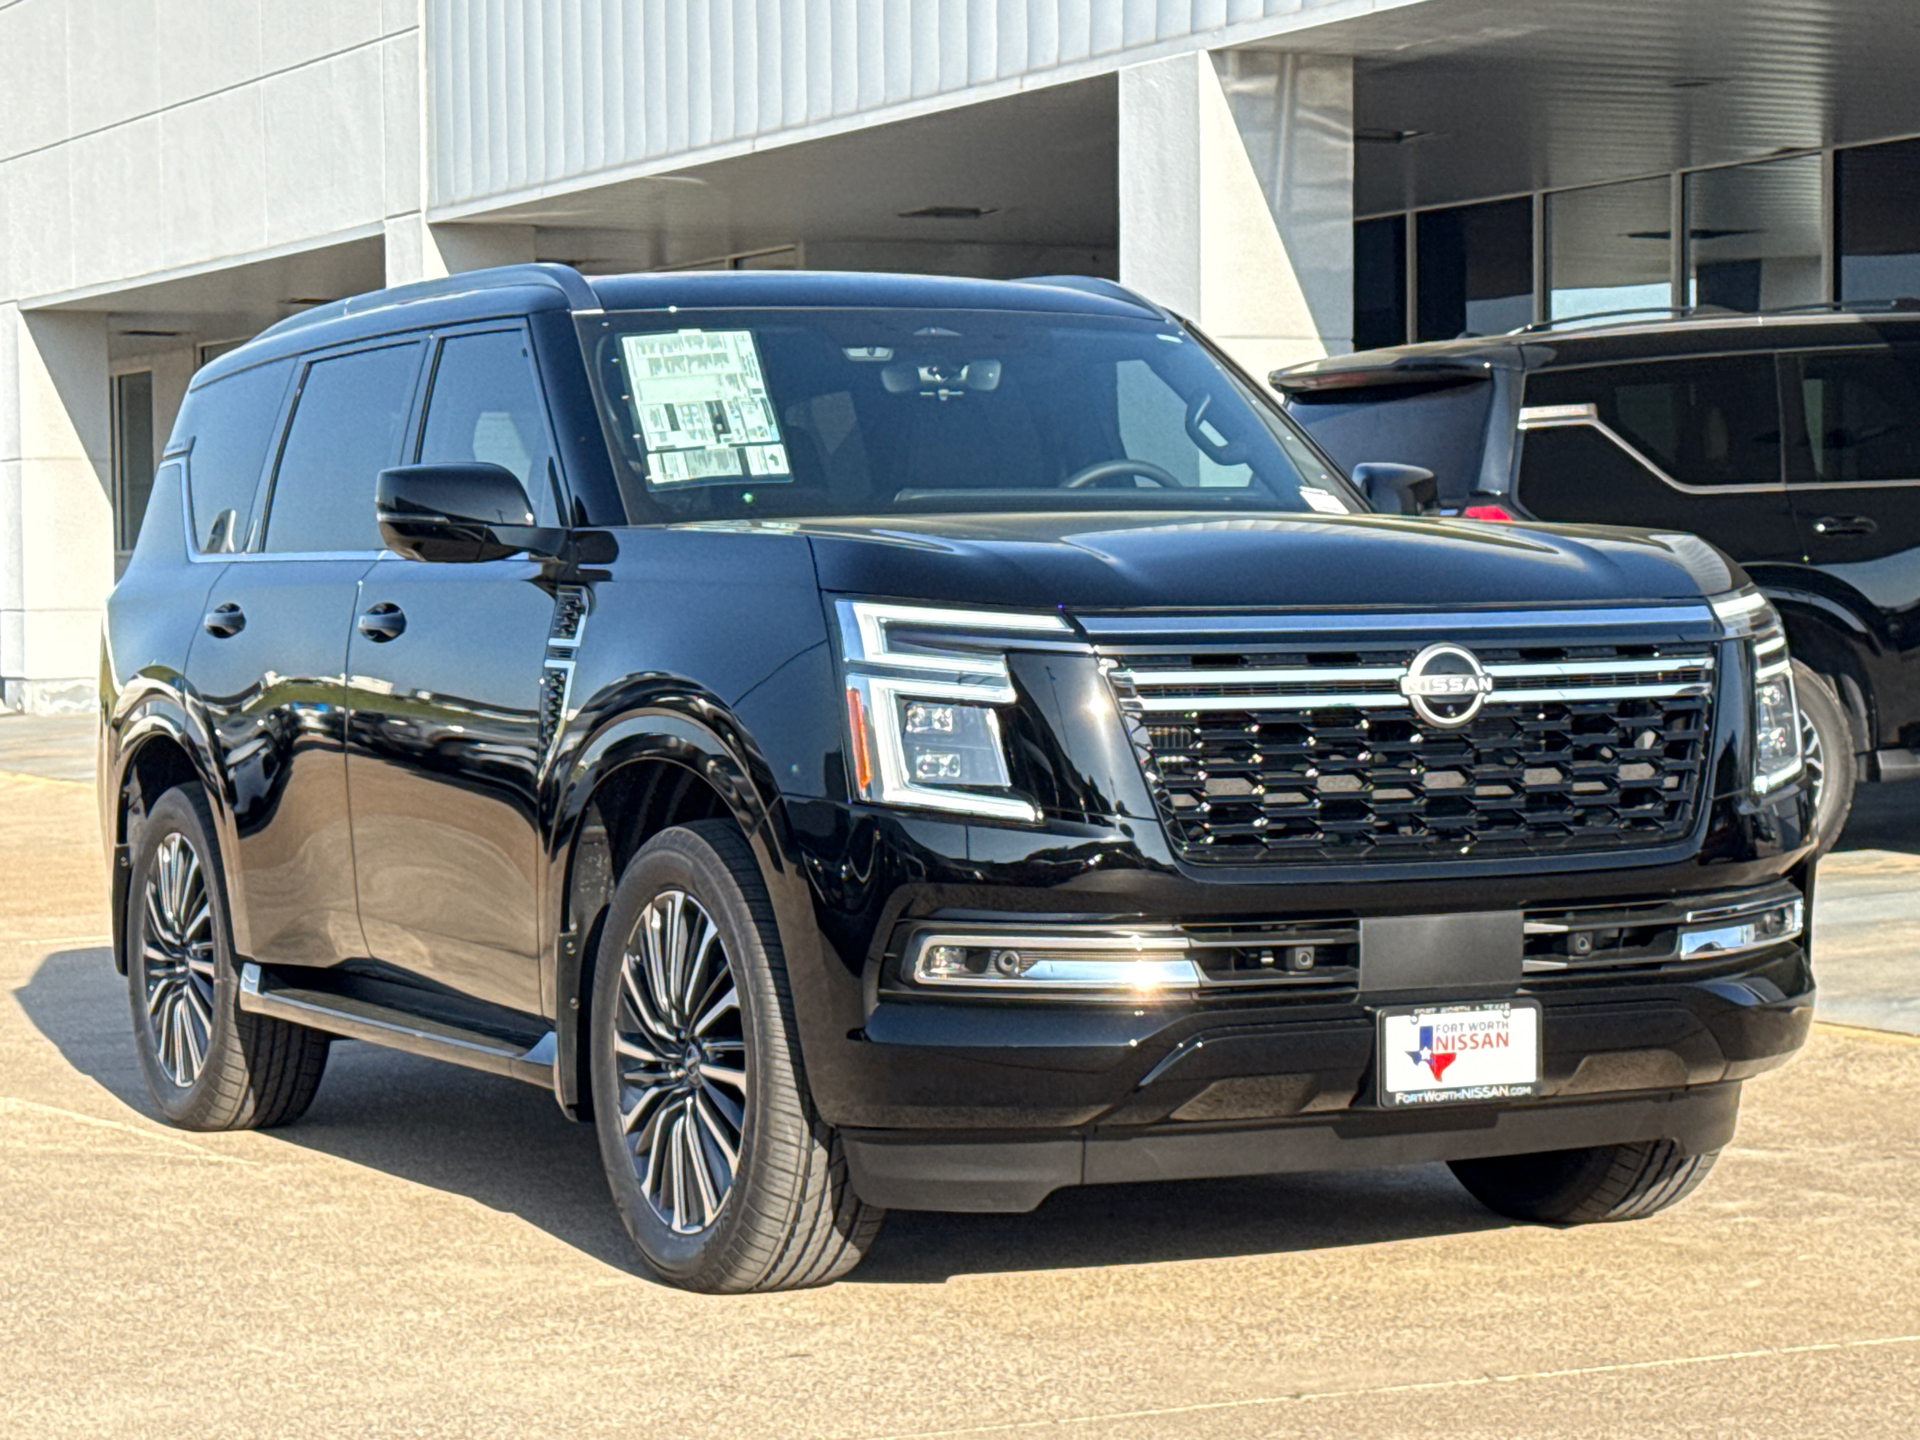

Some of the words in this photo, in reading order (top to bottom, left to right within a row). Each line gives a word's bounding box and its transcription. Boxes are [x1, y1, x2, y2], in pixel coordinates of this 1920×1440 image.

[1406, 677, 1493, 692] NISSAN
[1436, 1024, 1465, 1033] FORT
[1468, 1020, 1509, 1032] WORTH
[1436, 1032, 1509, 1050] NISSAN
